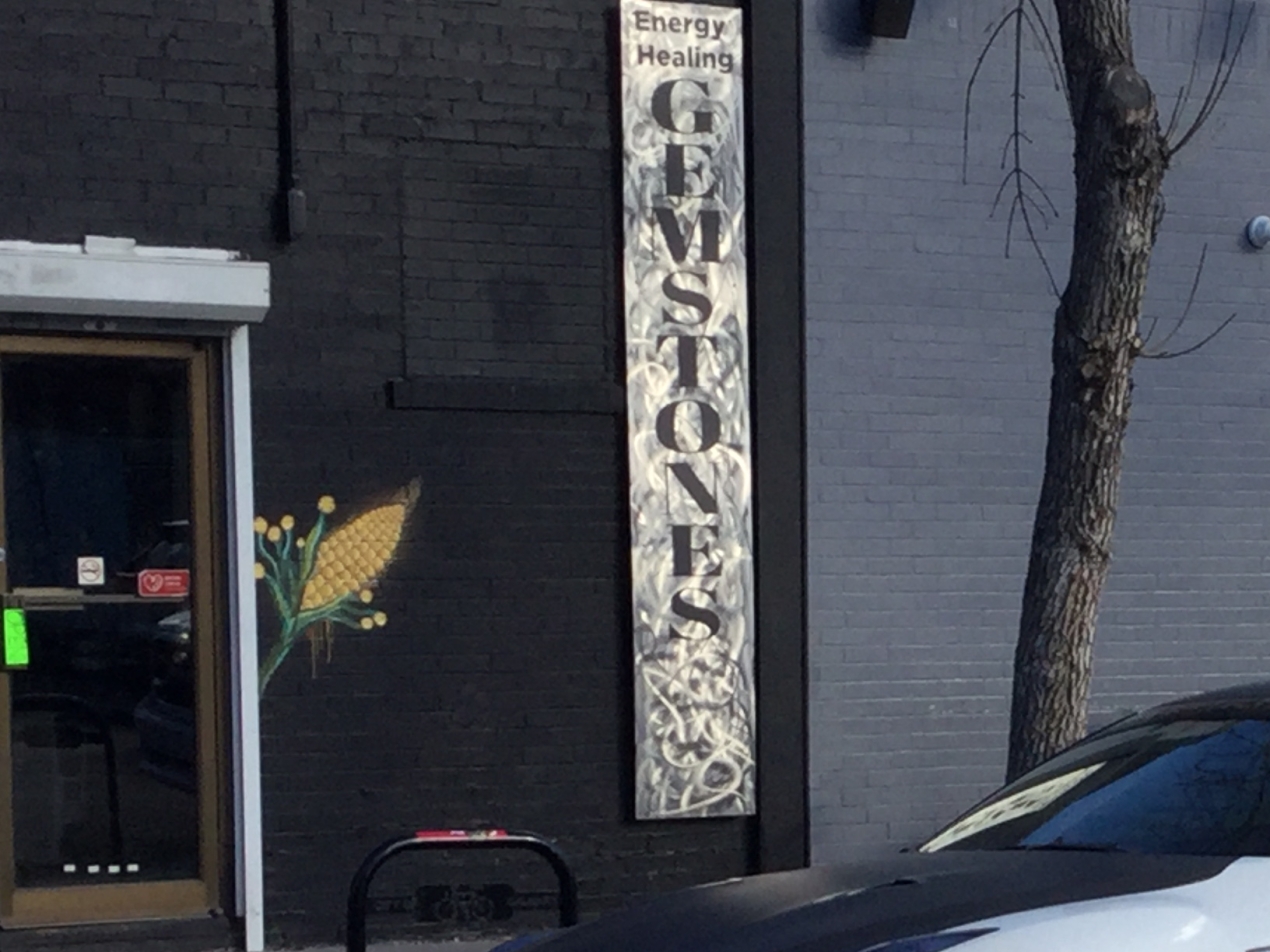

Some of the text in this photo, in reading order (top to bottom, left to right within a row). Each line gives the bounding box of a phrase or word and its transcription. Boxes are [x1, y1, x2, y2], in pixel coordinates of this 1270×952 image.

[634, 10, 726, 39] Energy
[637, 44, 735, 73] Healing
[651, 79, 722, 640] GEMSTONES
